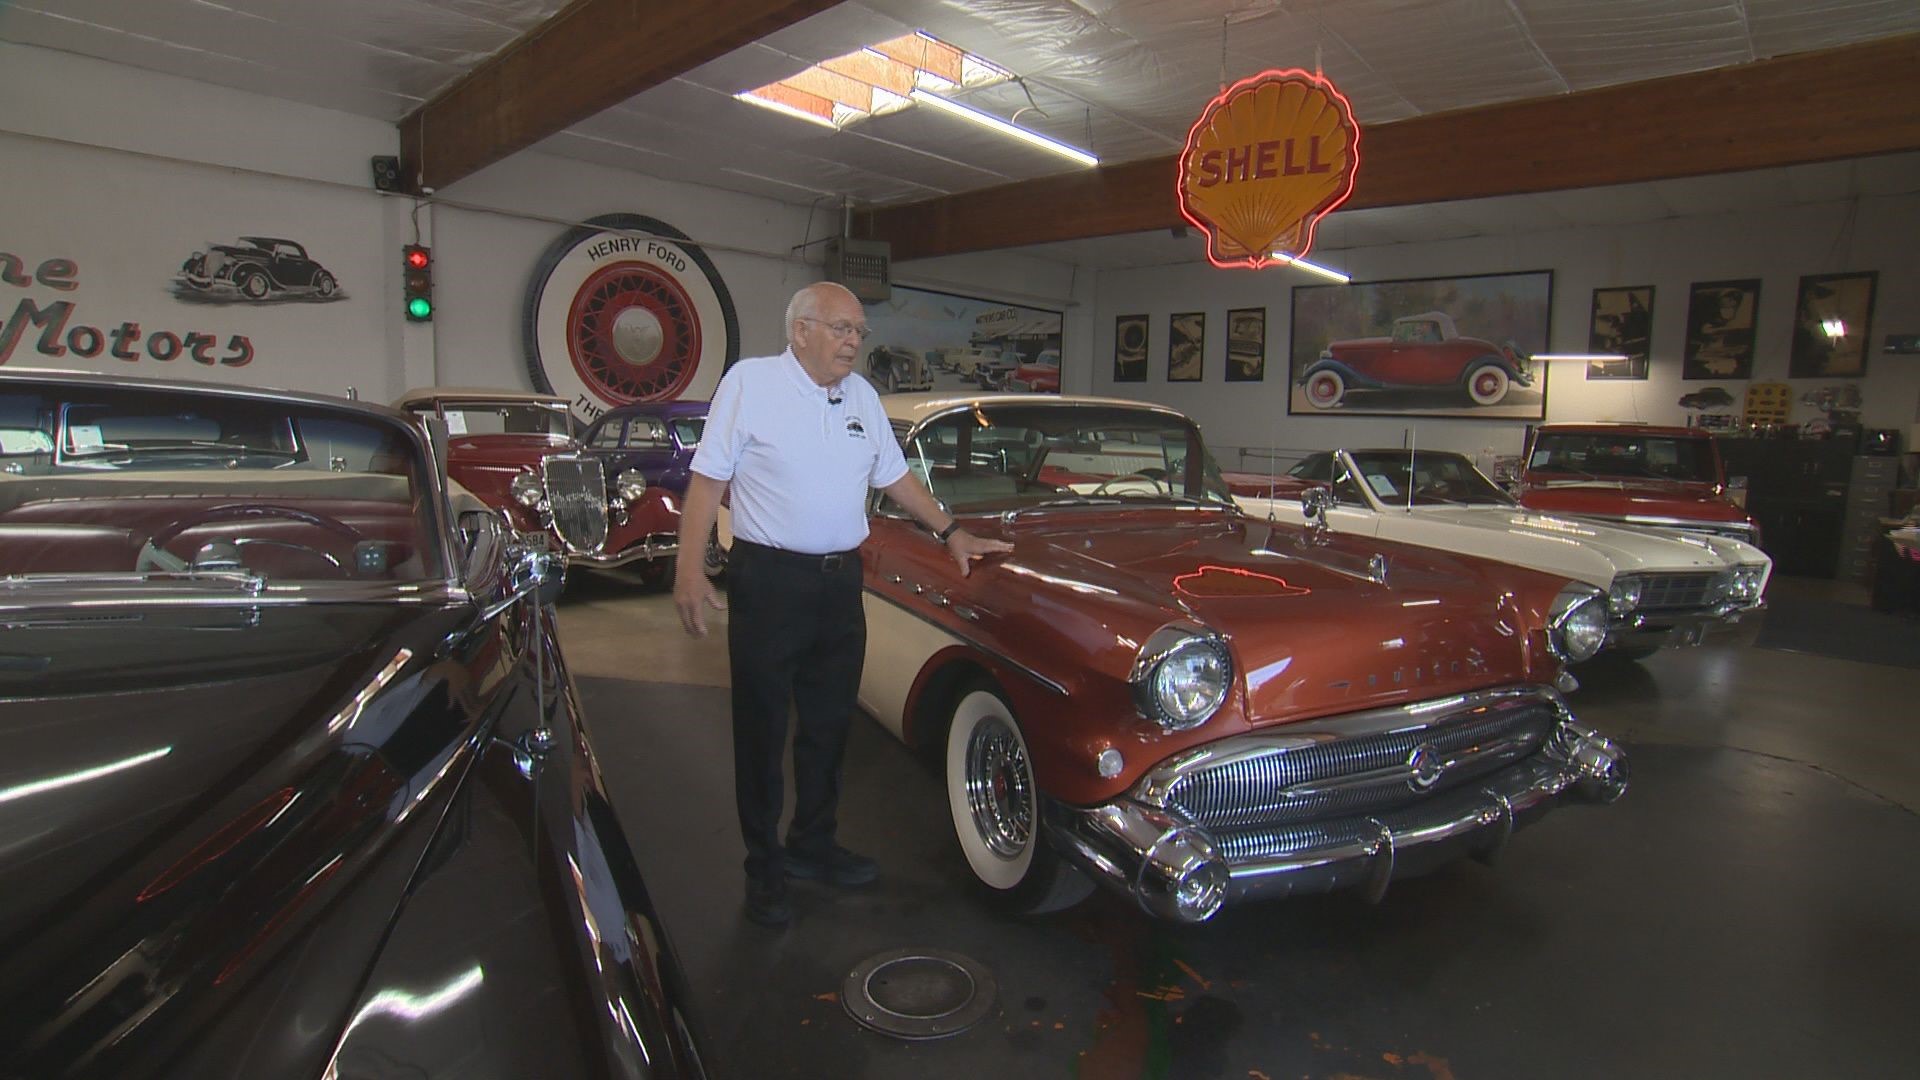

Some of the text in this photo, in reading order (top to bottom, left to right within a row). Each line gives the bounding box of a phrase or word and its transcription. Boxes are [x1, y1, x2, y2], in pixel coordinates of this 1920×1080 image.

[1198, 135, 1332, 188] SHELL
[587, 238, 686, 273] HENRY FORD
[0, 298, 254, 367] Motors
